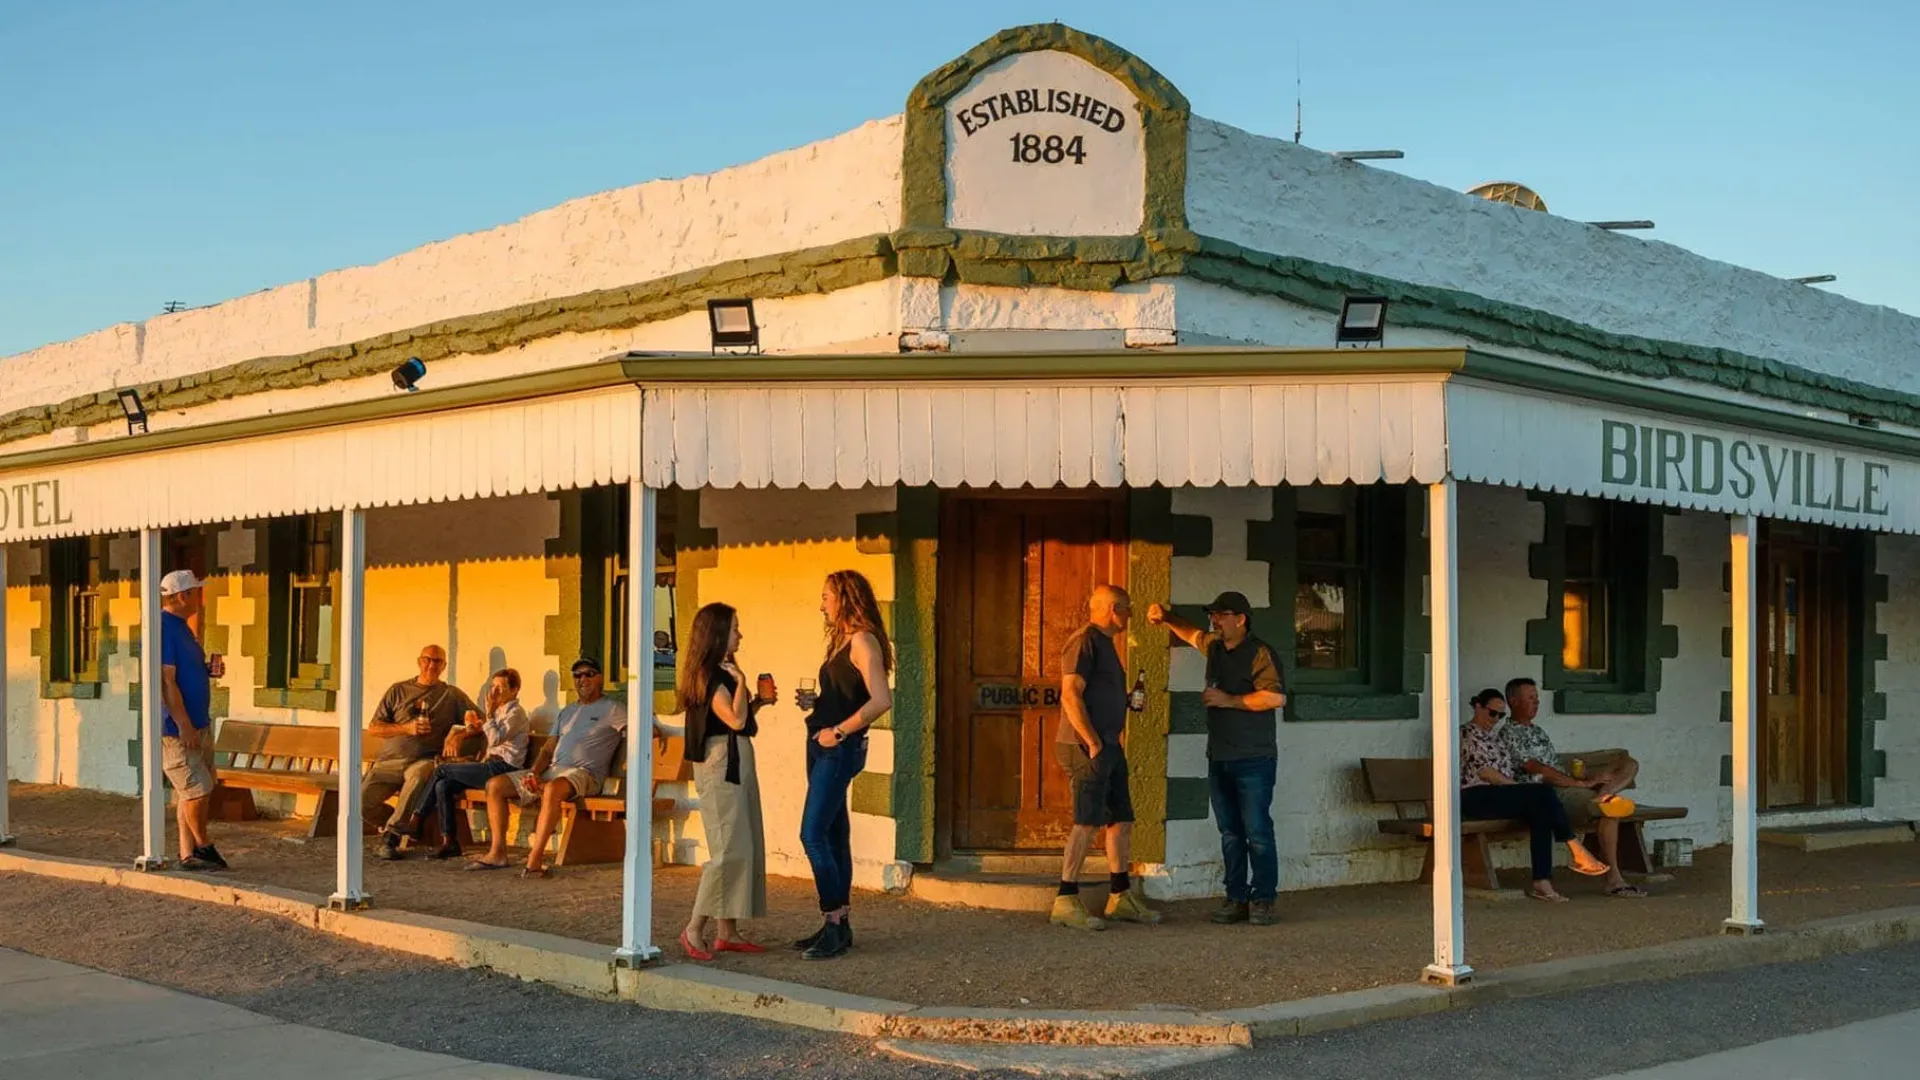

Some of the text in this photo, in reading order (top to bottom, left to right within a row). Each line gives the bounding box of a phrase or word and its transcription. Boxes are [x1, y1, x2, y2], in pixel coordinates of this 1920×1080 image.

[956, 88, 1125, 137] ESTABLISHED
[1010, 132, 1087, 165] 1884
[1602, 419, 1889, 515] BIRDSVILLE
[981, 687, 1039, 705] PUBLIC
